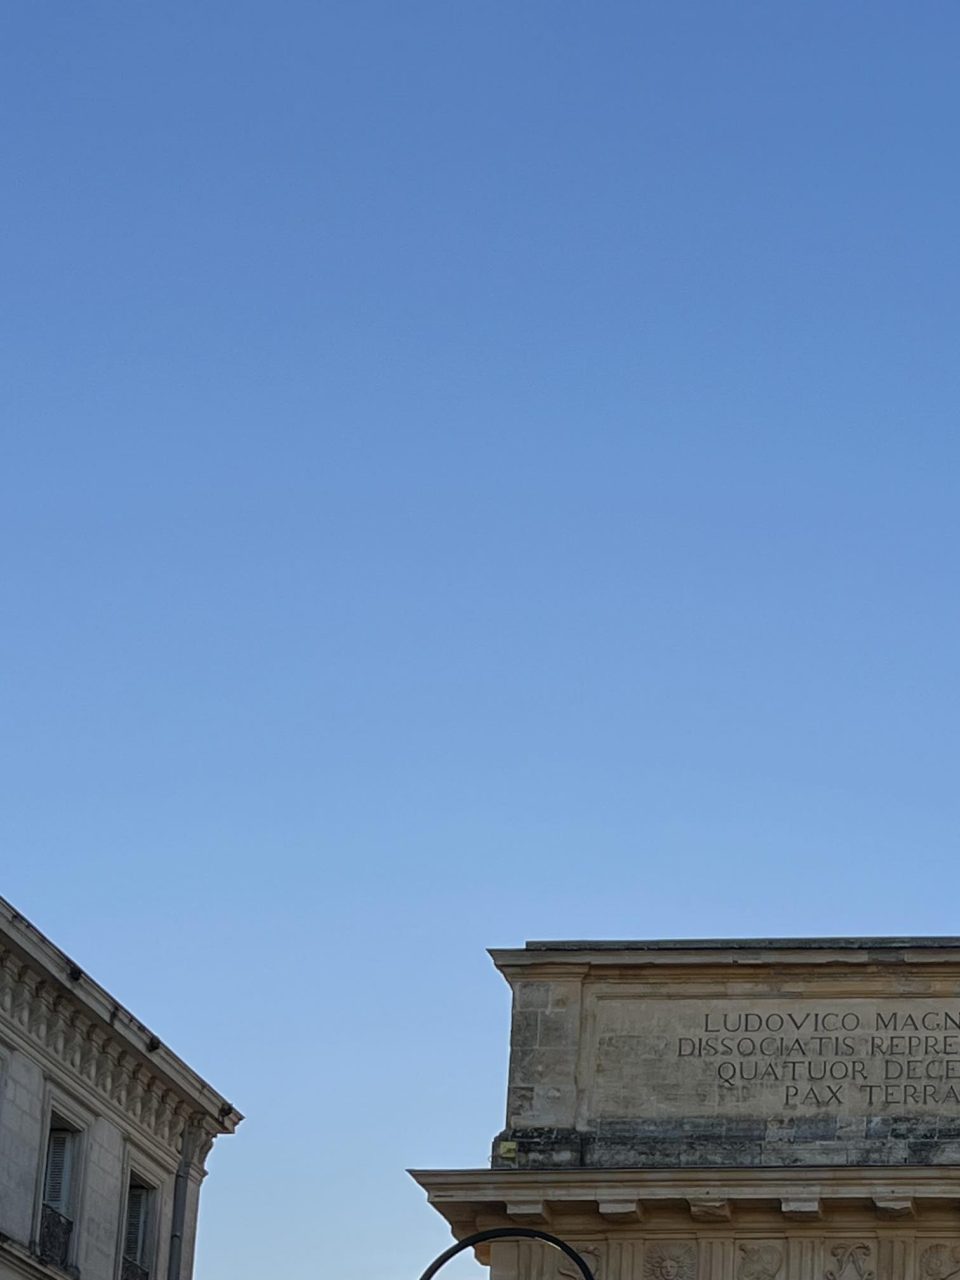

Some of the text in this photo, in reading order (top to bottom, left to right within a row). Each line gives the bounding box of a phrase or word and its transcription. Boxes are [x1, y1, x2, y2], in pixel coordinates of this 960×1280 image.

[703, 1012, 861, 1033] LUDOVICO
[677, 1036, 856, 1057] DISSOCIATIS
[717, 1060, 868, 1087] QUATUOR
[784, 1084, 844, 1106] PAX
[859, 1083, 960, 1105] TERRA
